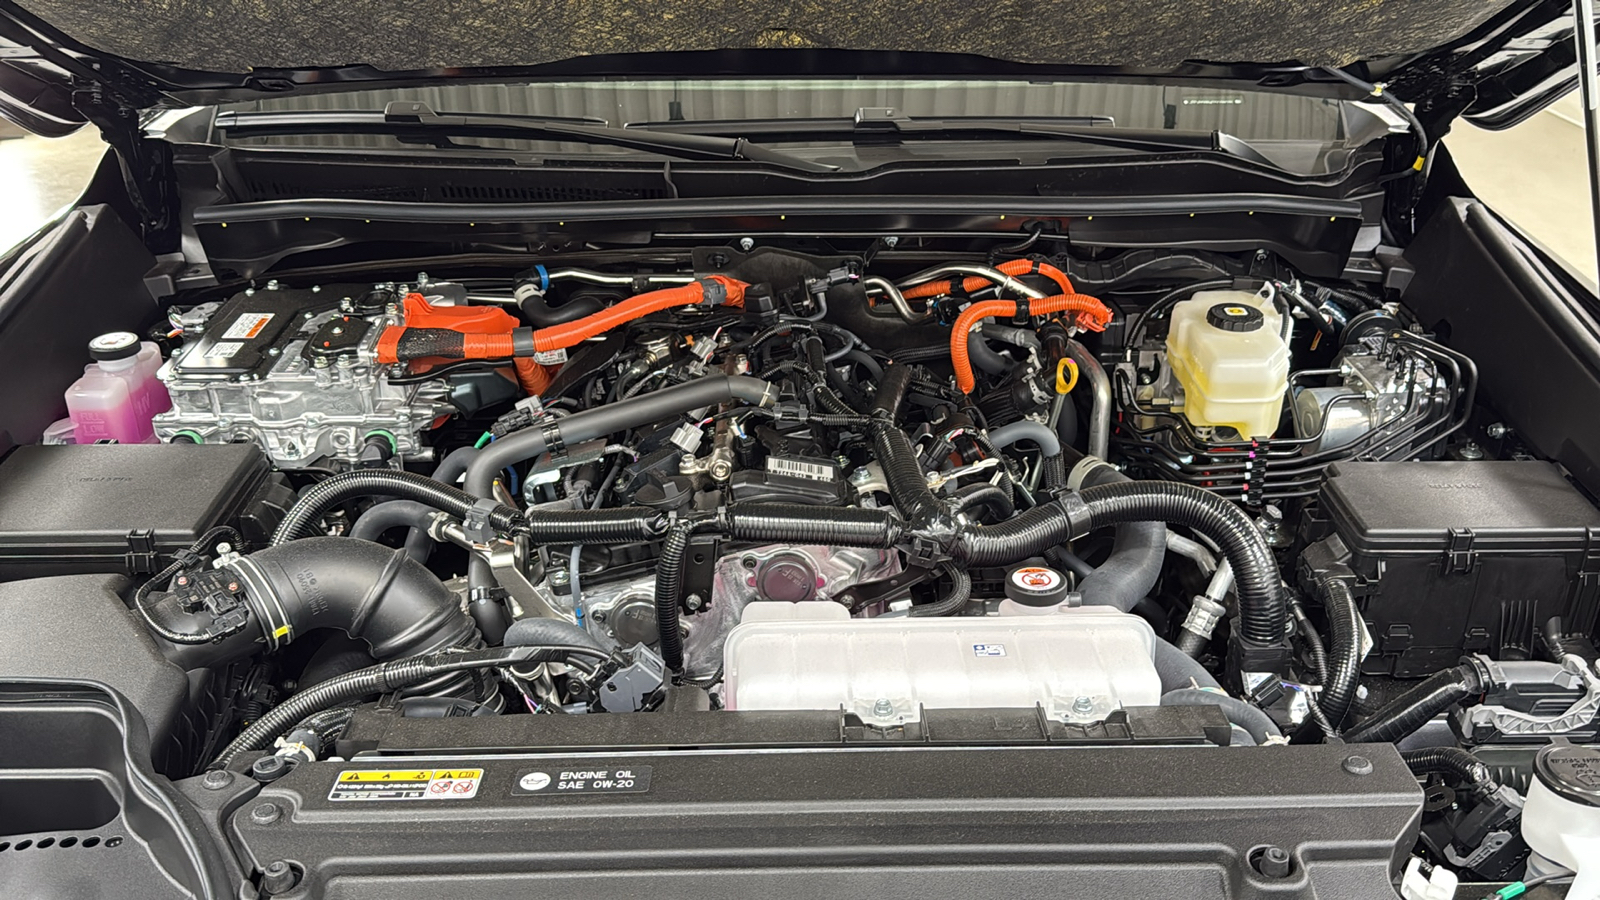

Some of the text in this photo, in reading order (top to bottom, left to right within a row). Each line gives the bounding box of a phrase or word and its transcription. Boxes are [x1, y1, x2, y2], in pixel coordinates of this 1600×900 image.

[80, 412, 102, 421] FULL
[83, 425, 105, 434] LOW
[560, 770, 636, 780] ENGINE OIL
[557, 780, 634, 790] SAE 0W-20
